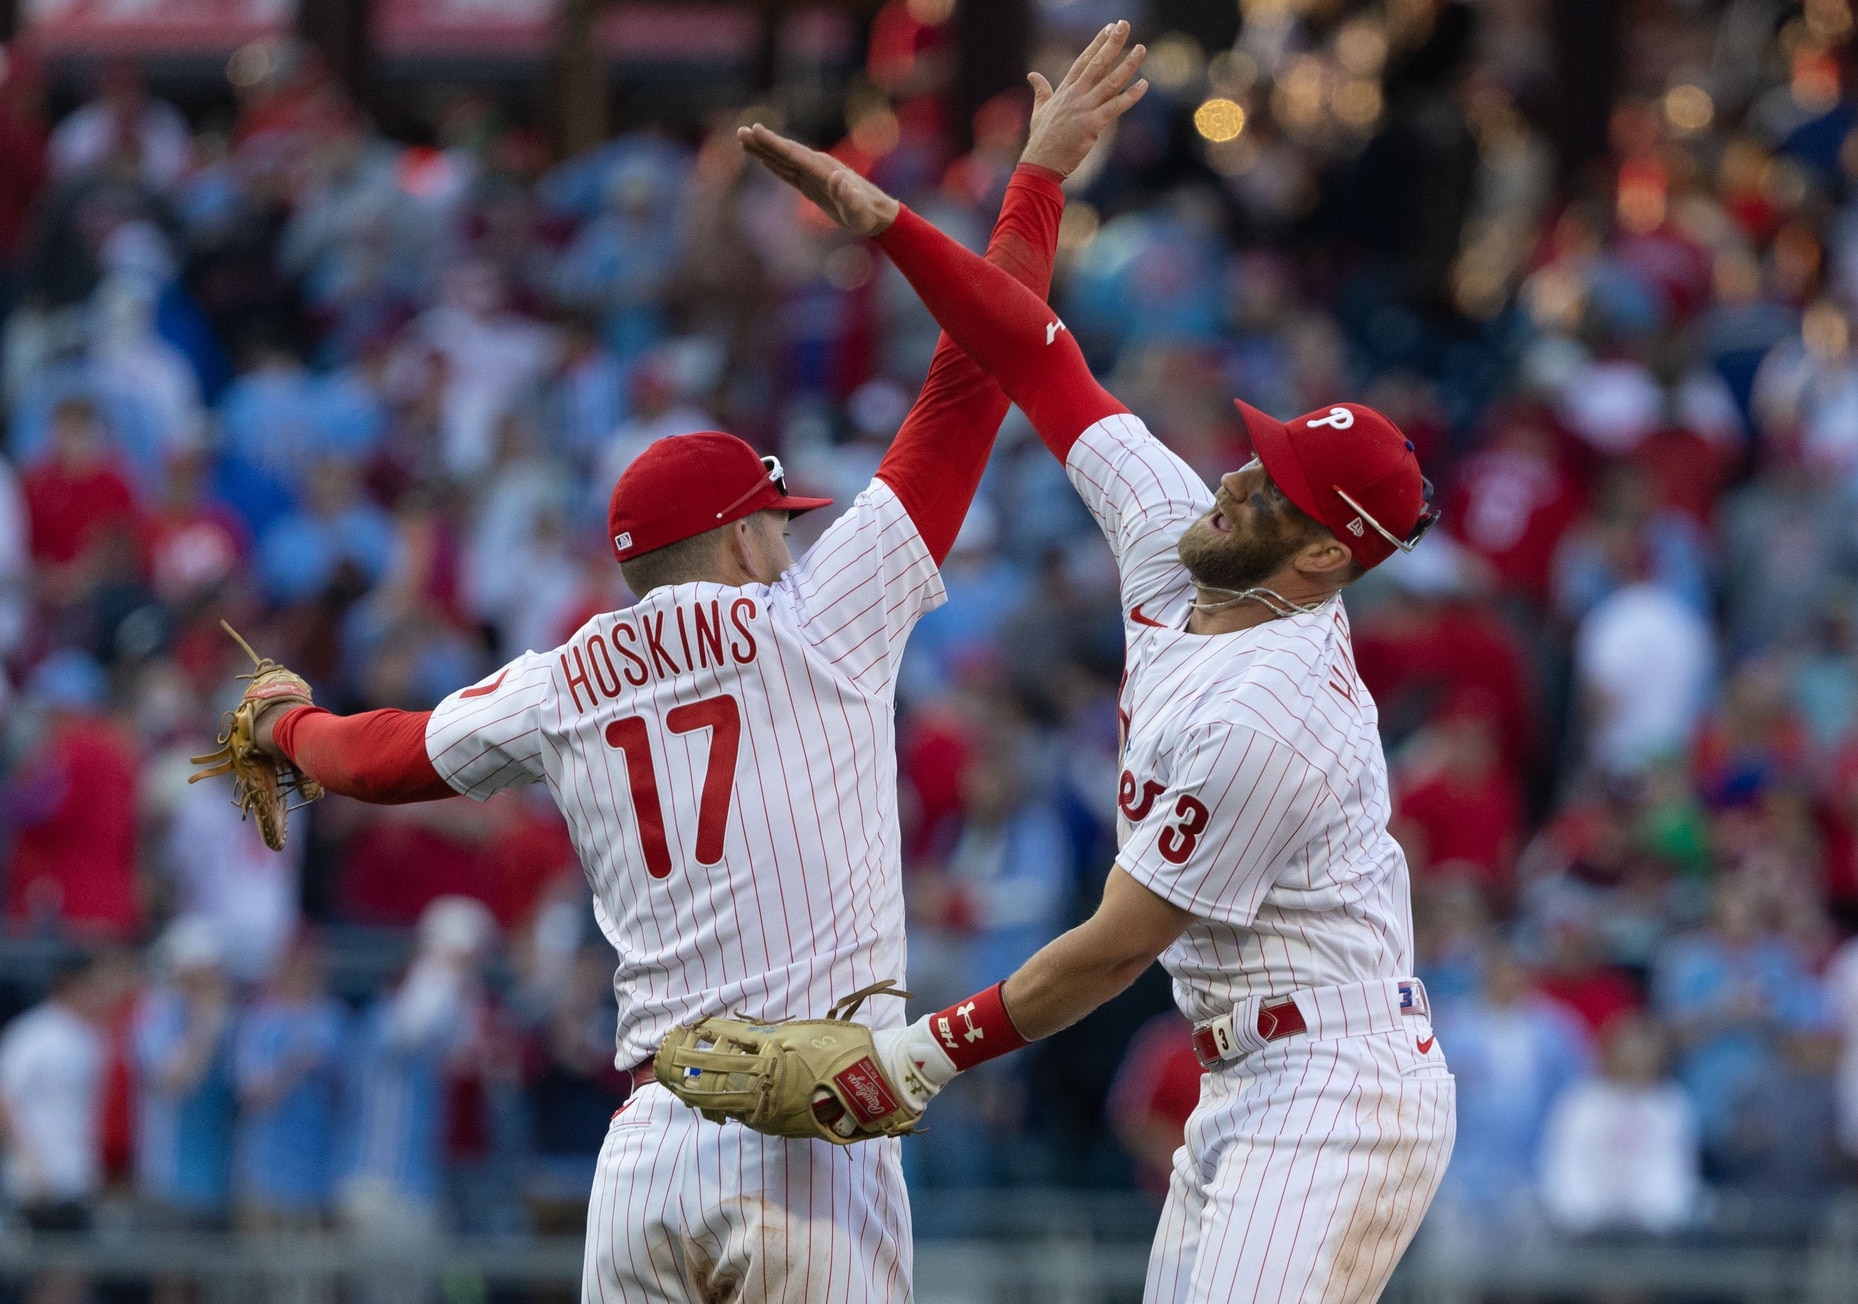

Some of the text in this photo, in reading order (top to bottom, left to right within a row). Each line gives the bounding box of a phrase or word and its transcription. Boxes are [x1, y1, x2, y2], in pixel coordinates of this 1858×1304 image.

[1306, 406, 1354, 430] P
[560, 597, 757, 715] HOSKINS
[605, 694, 741, 880] 17
[1158, 794, 1210, 865] 3
[1218, 1027, 1230, 1051] 3
[847, 1073, 885, 1114] Rawlings
